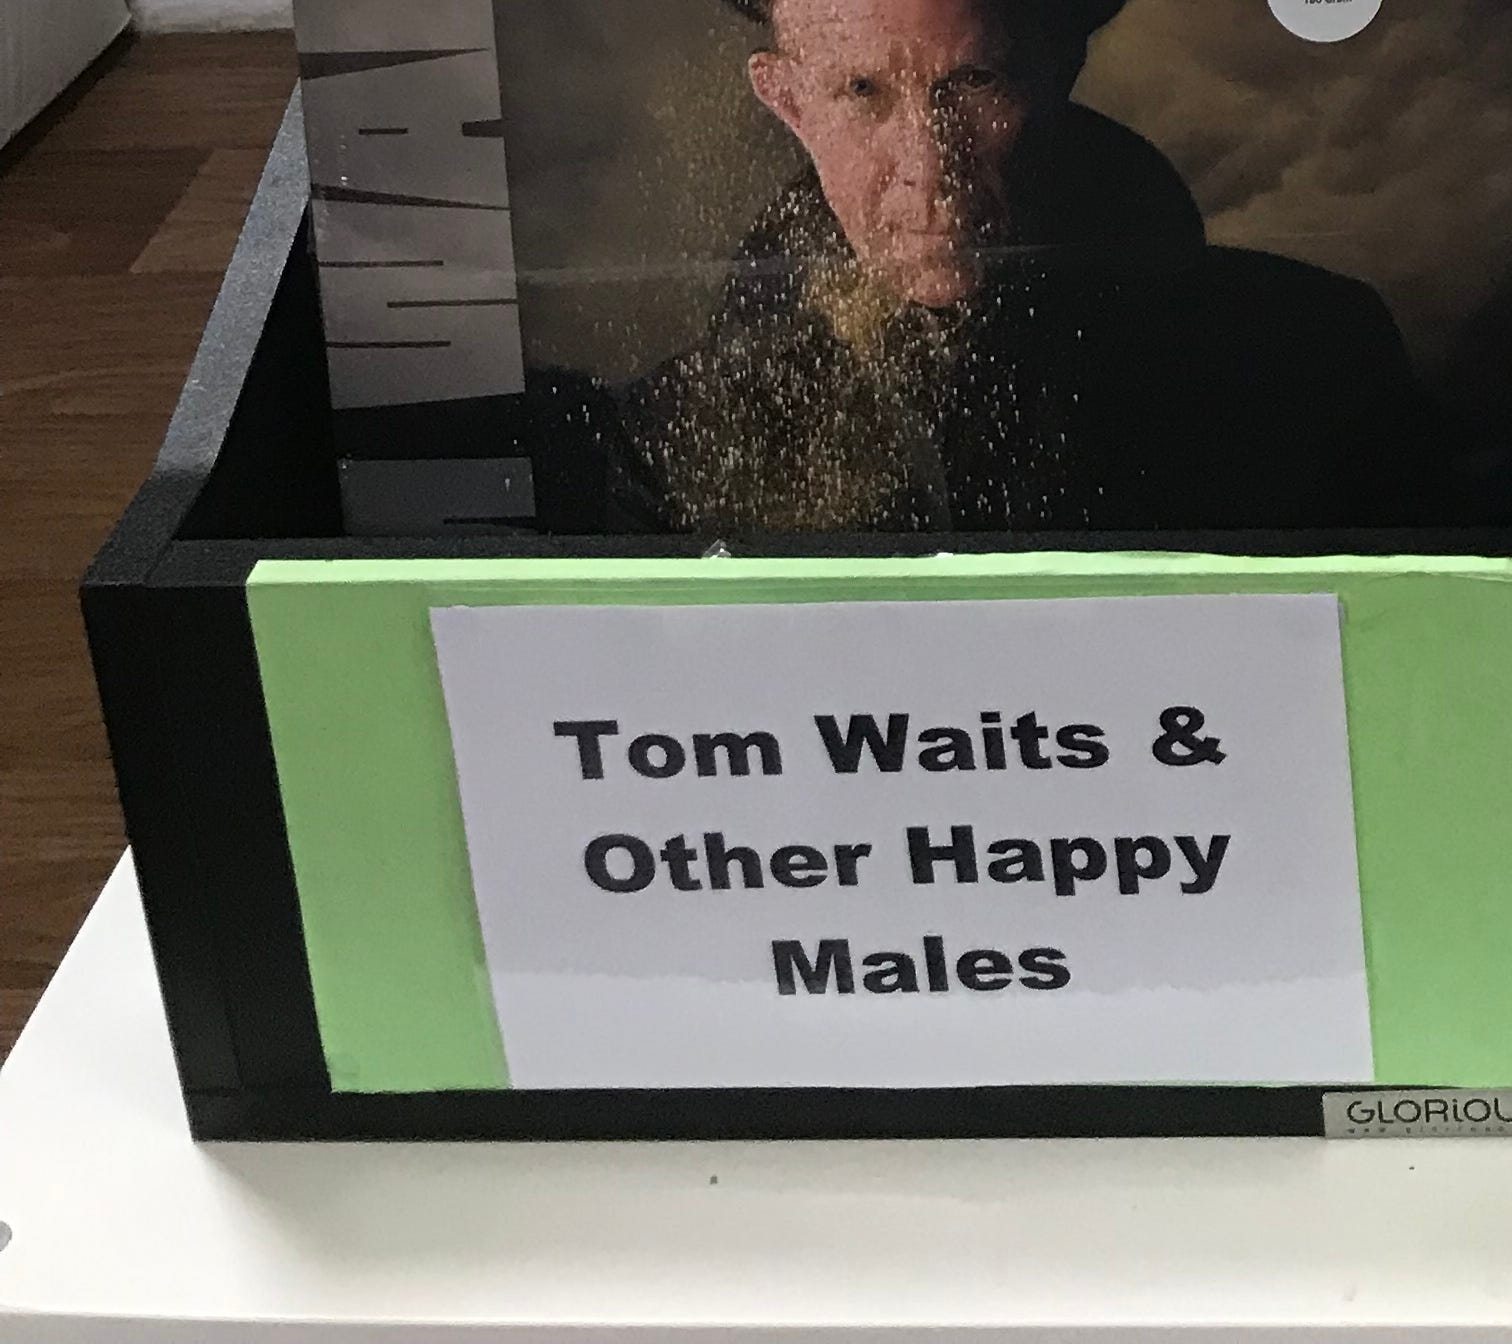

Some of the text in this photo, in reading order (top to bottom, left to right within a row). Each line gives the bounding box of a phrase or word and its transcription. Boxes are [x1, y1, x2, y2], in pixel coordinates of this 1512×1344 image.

[554, 706, 1227, 780] Tom Waits &
[583, 823, 1230, 897] Other Happy
[770, 933, 1072, 996] Males
